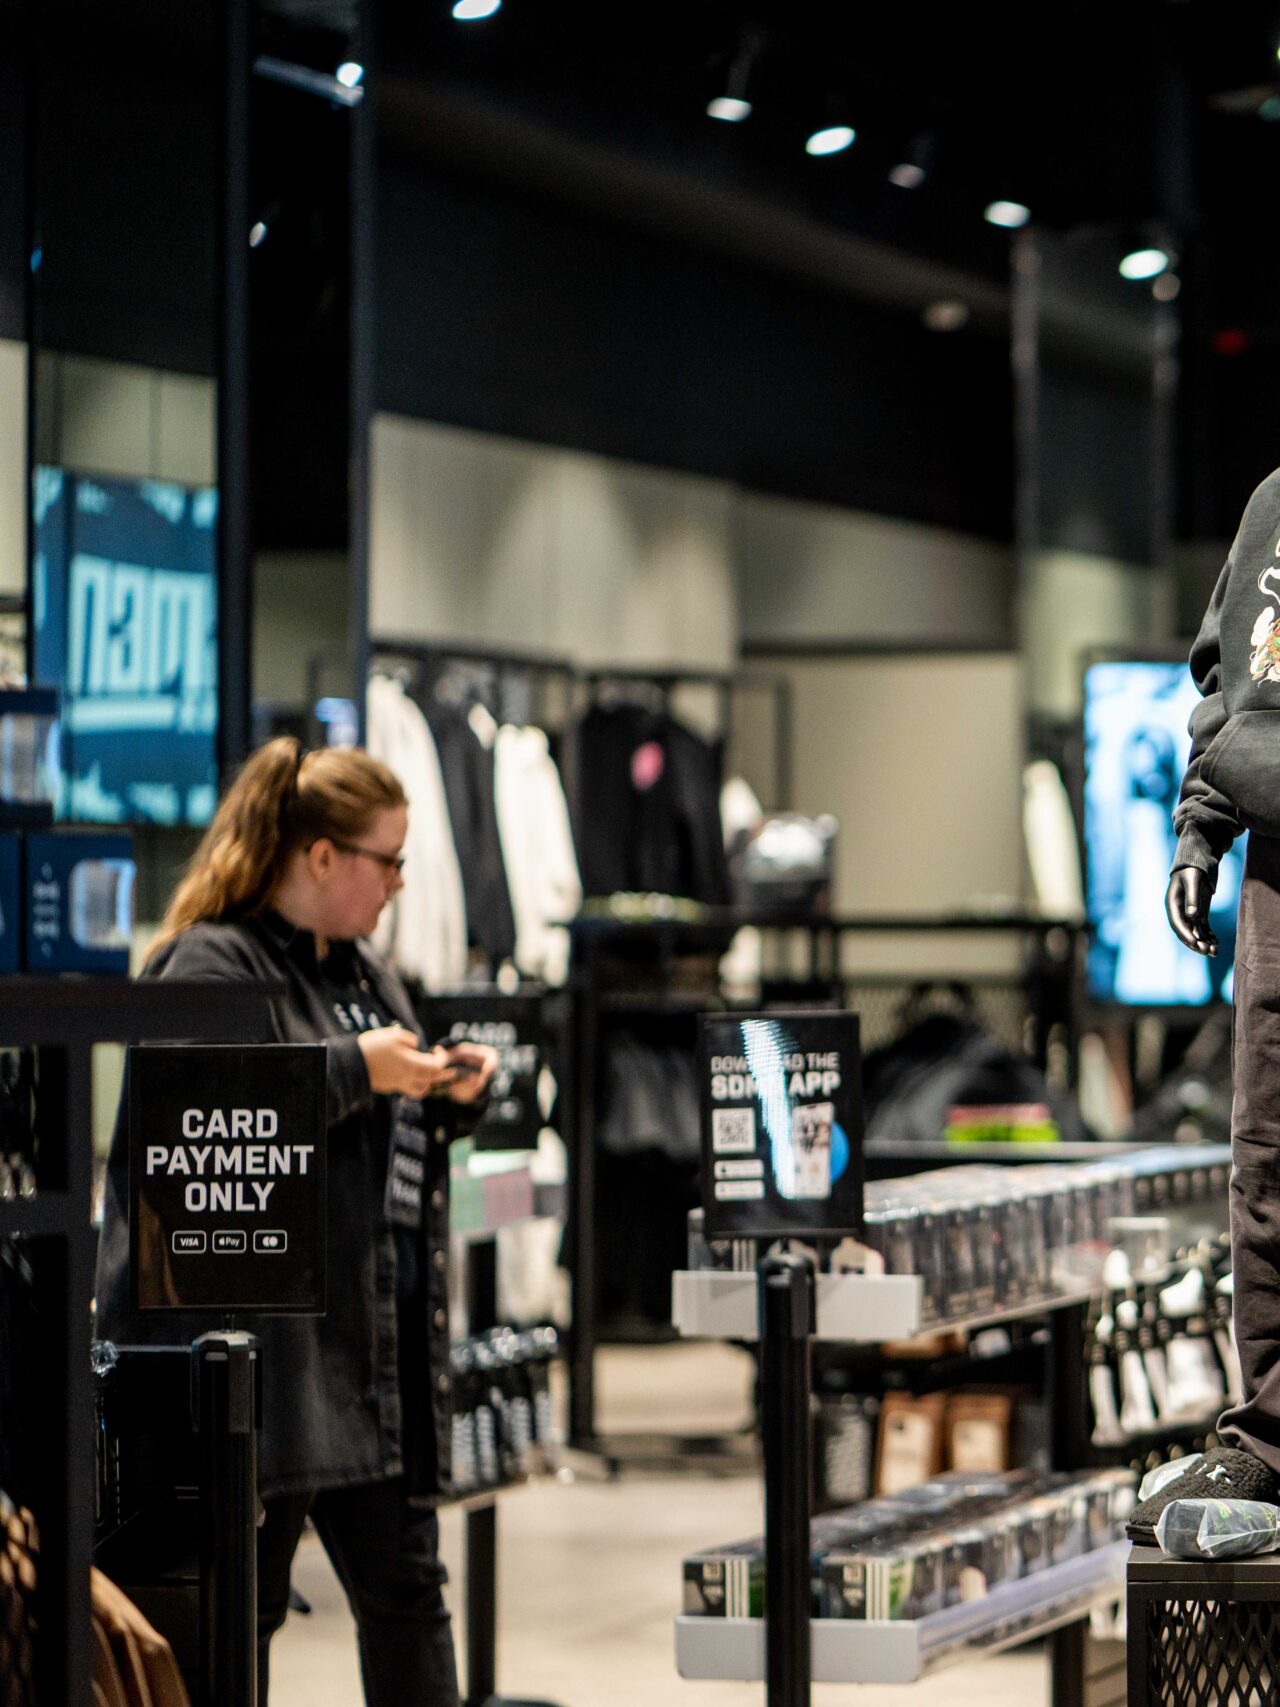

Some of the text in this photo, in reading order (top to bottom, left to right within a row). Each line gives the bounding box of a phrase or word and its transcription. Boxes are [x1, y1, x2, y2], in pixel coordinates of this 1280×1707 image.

[806, 1051, 840, 1072] THE
[788, 1071, 841, 1097] APP
[182, 1108, 278, 1138] CARD
[146, 1145, 315, 1175] PAYMENT
[184, 1182, 275, 1212] ONLY
[180, 1237, 240, 1247] VISA Pay
